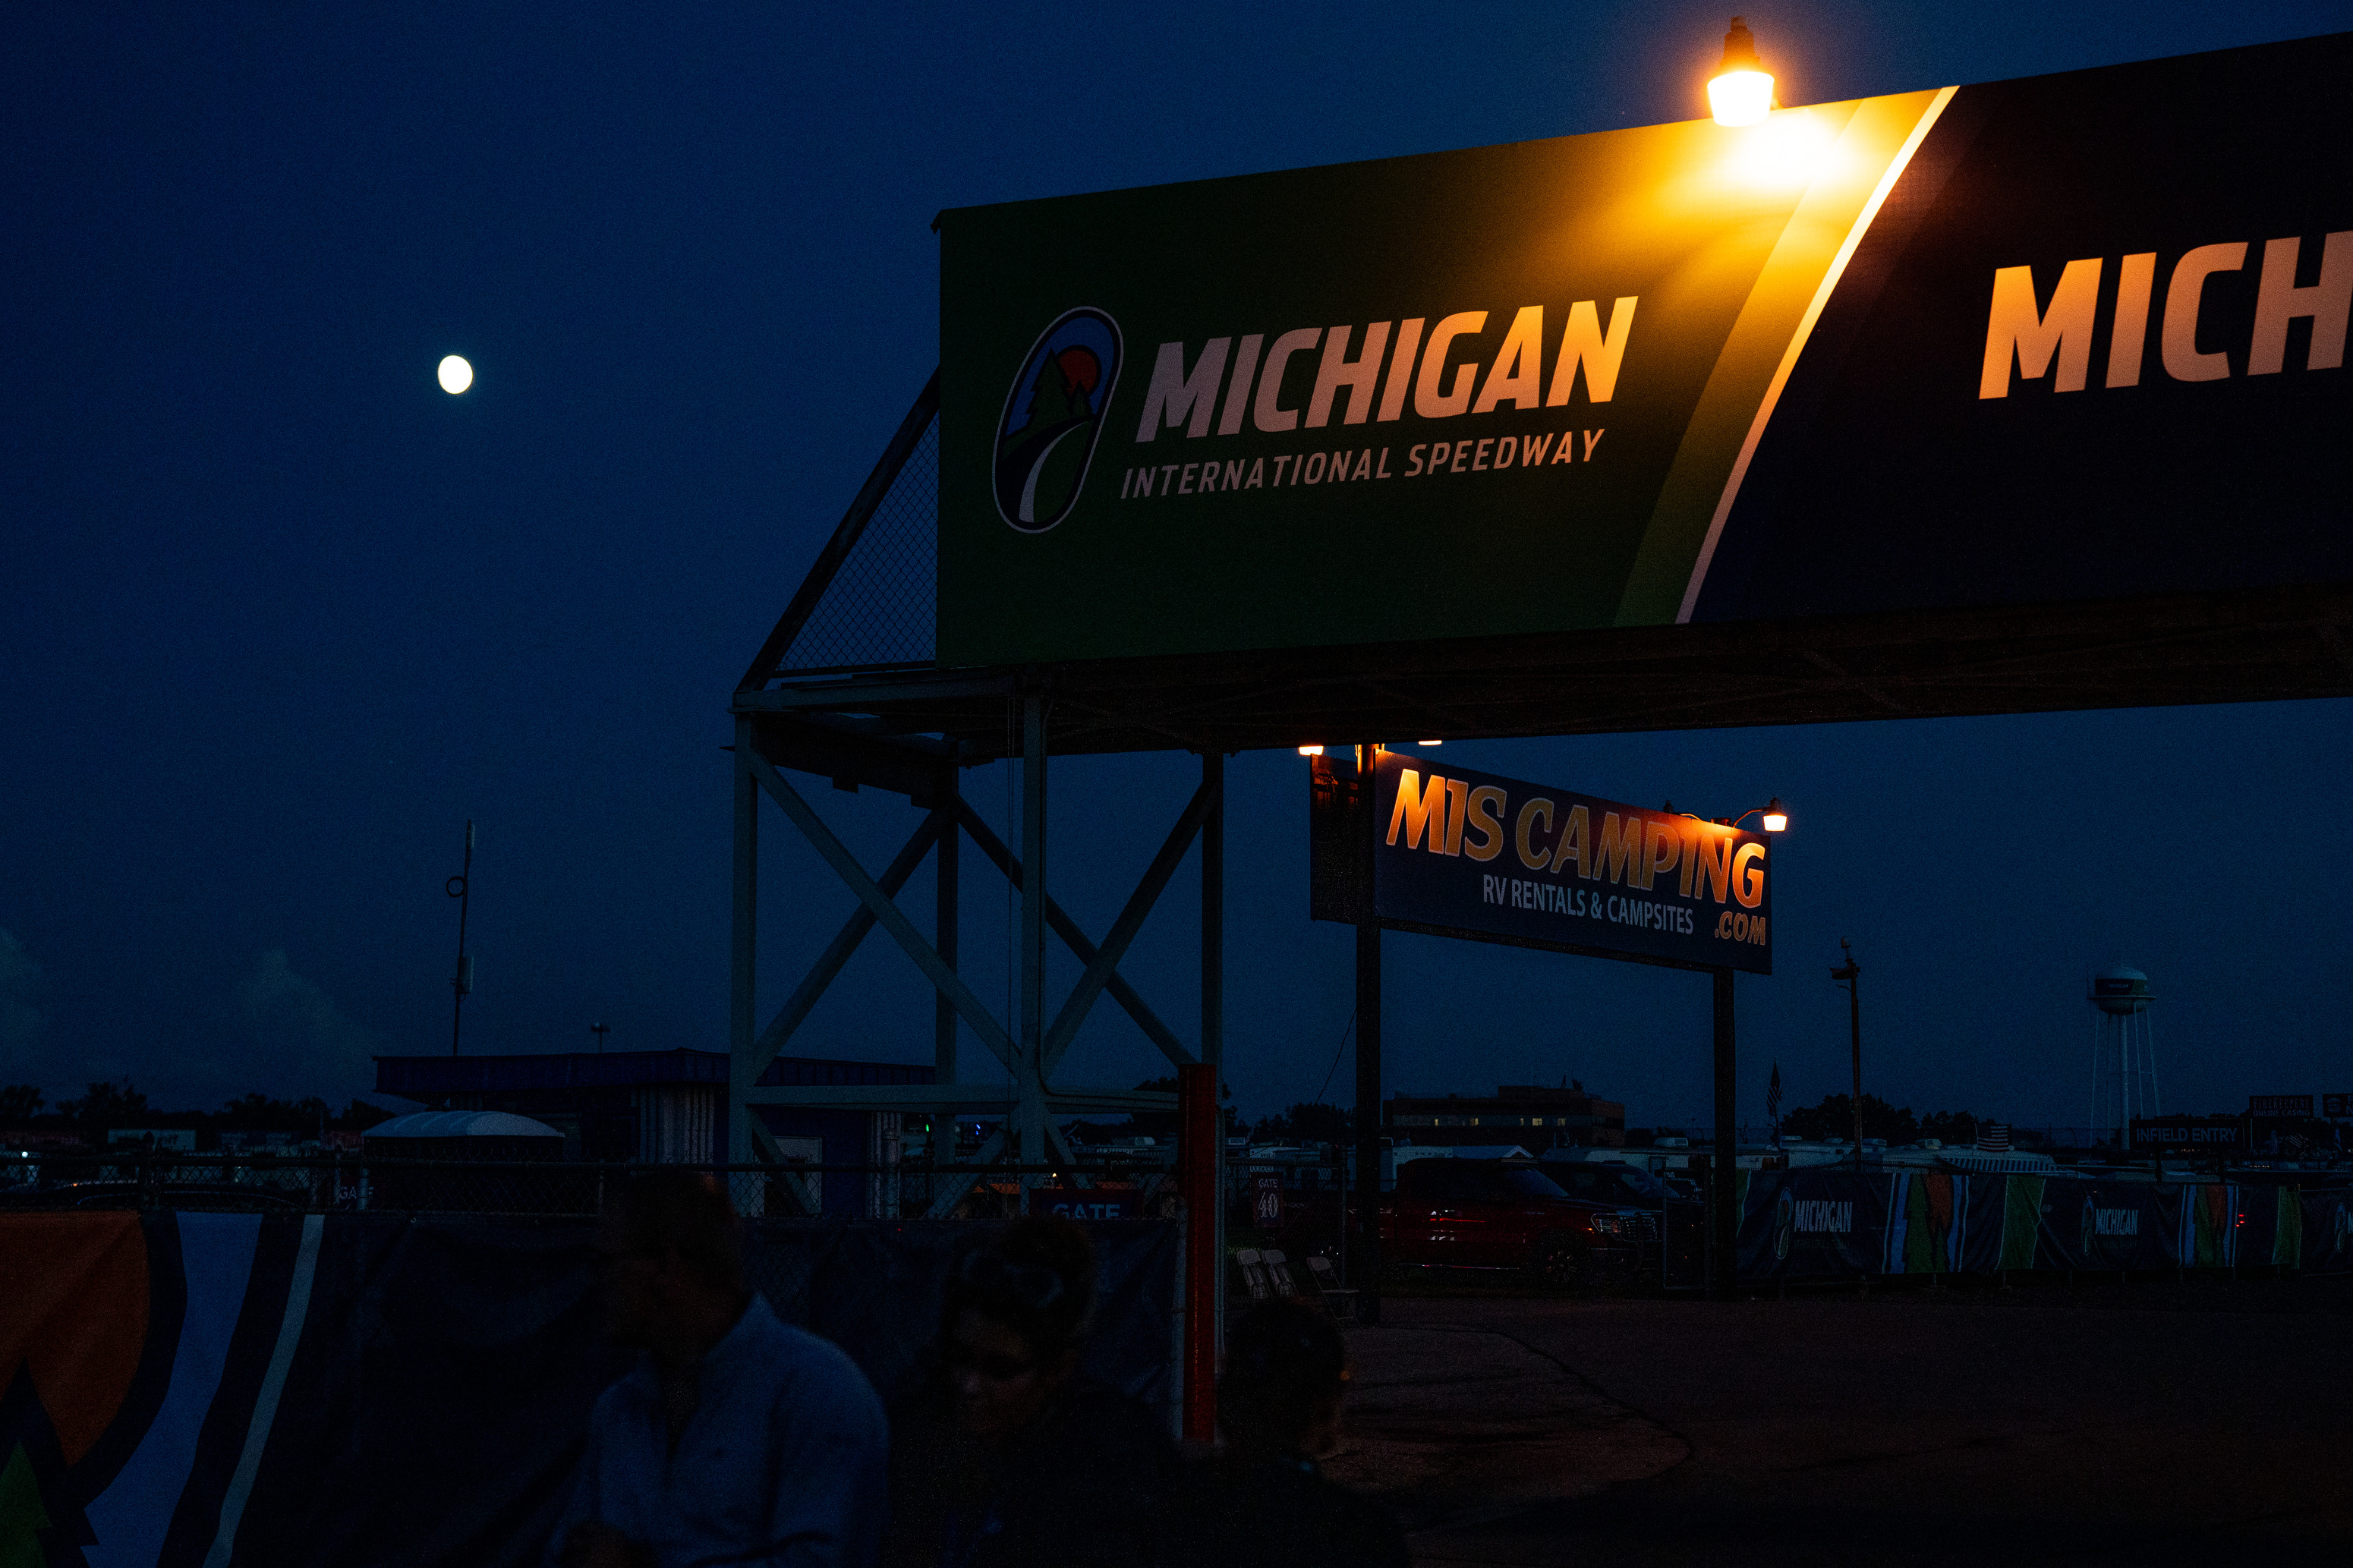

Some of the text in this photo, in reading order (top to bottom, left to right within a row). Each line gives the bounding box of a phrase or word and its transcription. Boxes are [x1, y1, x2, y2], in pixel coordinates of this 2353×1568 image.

[1979, 230, 2353, 399] MICH
[1136, 296, 1639, 442] MICHIGAN
[1120, 428, 1605, 499] INTERNATIONAL SPEEDWAY
[1515, 797, 1766, 908] CAMPING
[1483, 874, 1694, 935] RV RENTALS & CAMPSITES
[1714, 910, 1766, 946] .COM
[2282, 1108, 2310, 1116] CASINO
[2135, 1127, 2238, 1143] INFIELD ENTRY
[1258, 1178, 1278, 1189] GATE
[1258, 1191, 1279, 1218] 40
[1794, 1200, 1854, 1233] MICHIGAN
[2095, 1207, 2139, 1236] MICHIGAN
